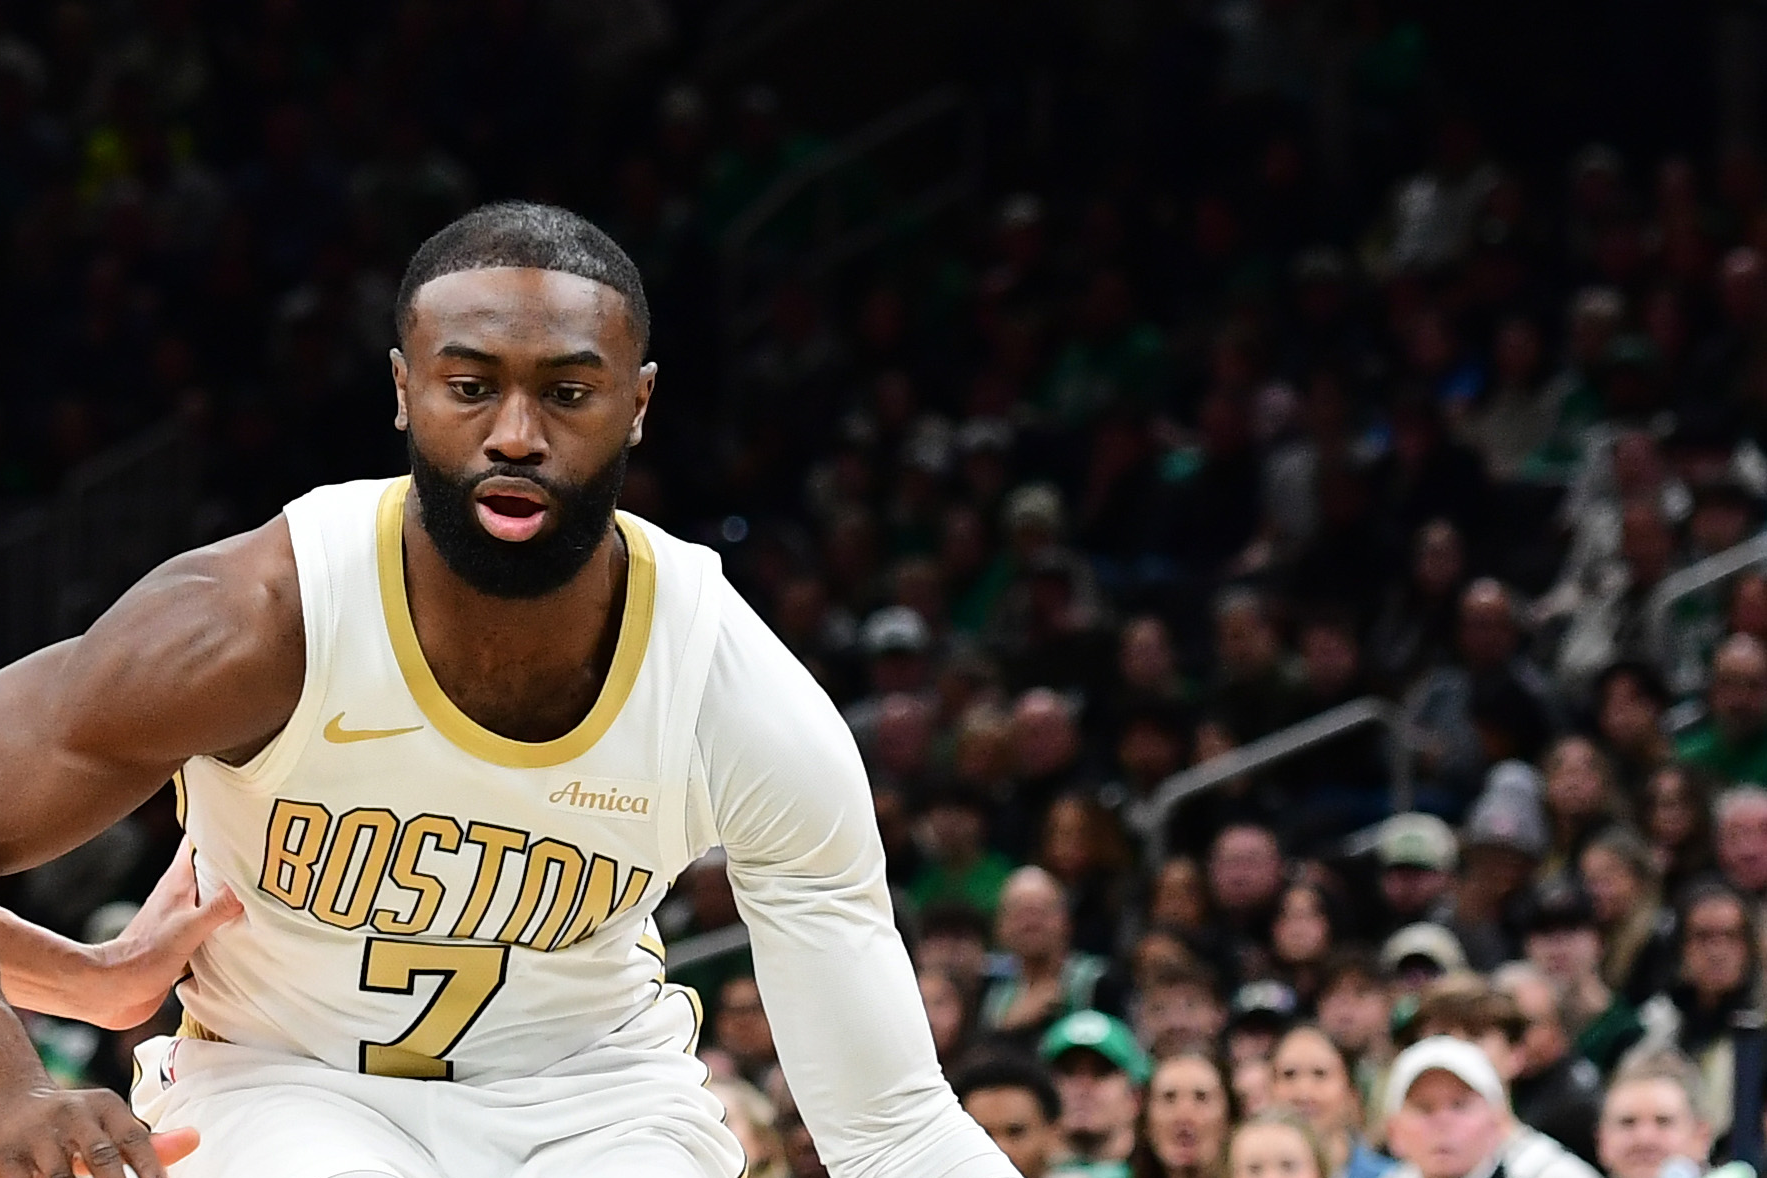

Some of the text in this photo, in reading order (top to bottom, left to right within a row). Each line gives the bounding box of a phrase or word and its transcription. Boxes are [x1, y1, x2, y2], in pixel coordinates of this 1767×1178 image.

[548, 780, 649, 815] Amica
[257, 798, 654, 953] BOSTON
[358, 936, 511, 1082] 7
